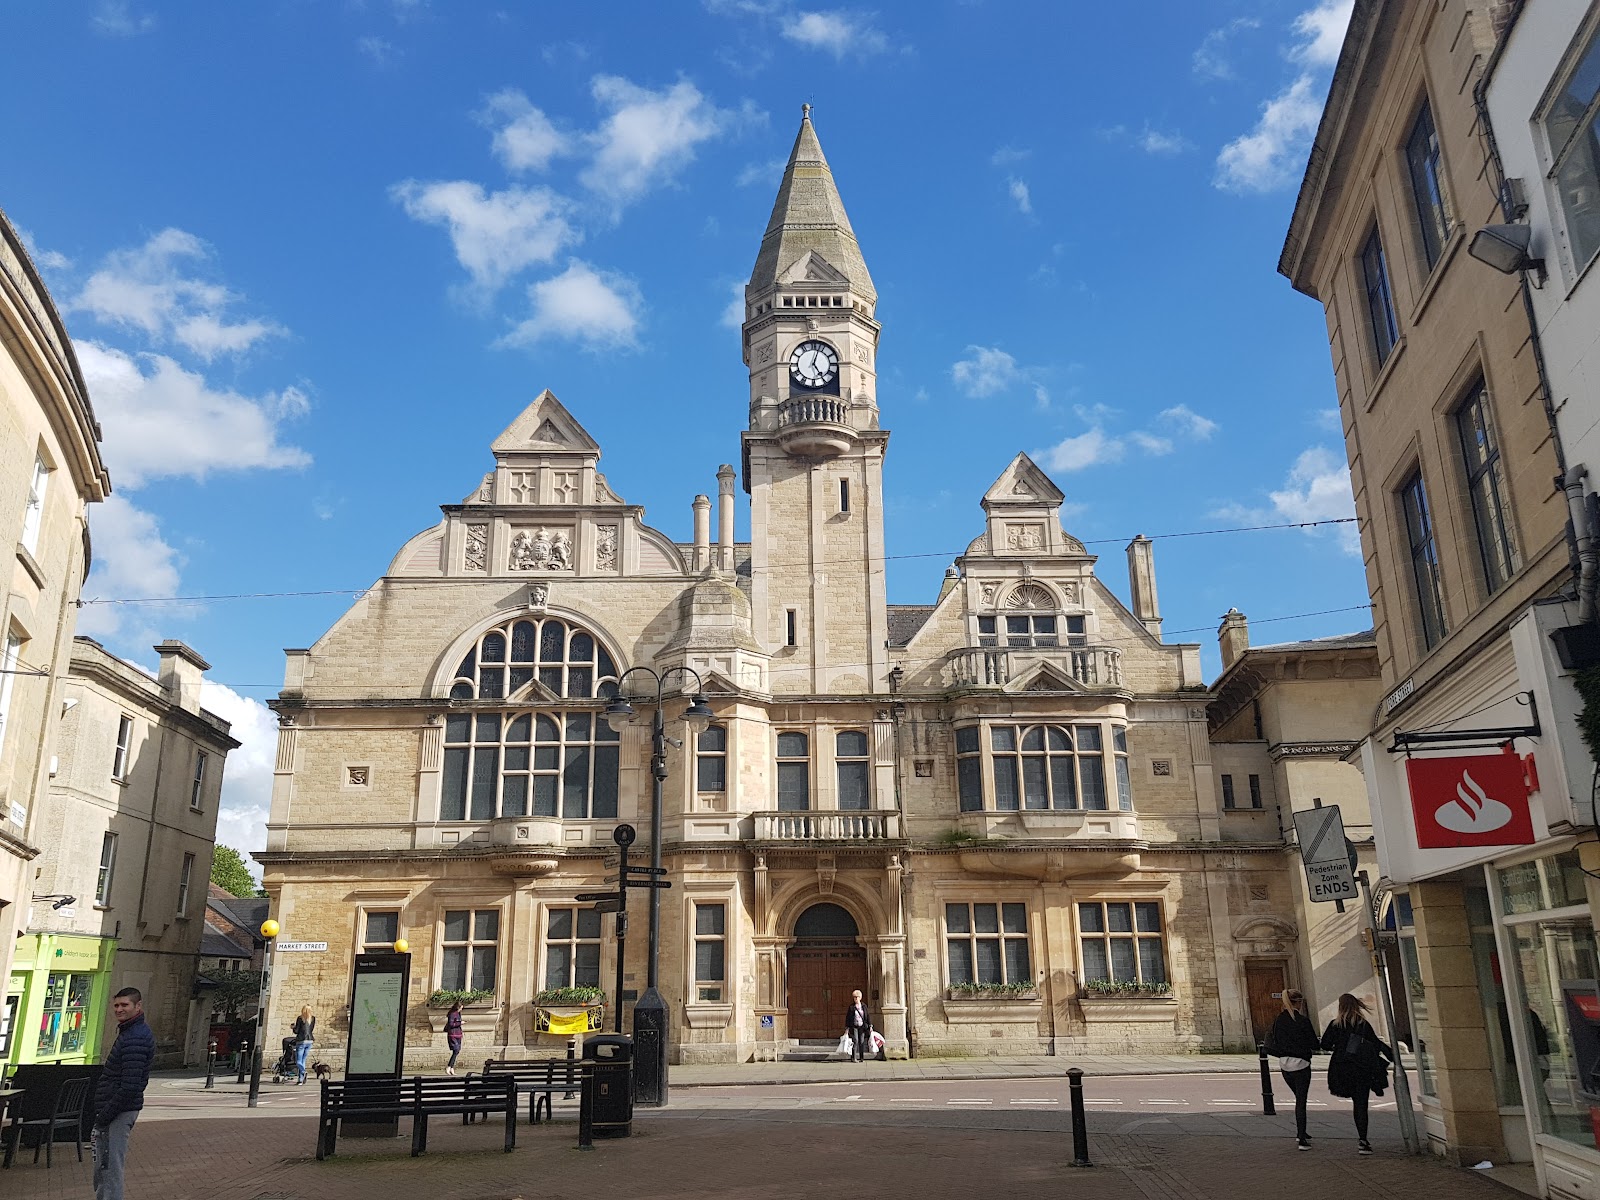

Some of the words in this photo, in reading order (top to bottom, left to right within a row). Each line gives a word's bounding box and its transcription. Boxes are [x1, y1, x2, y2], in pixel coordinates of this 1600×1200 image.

[1387, 692, 1398, 709] FORE
[1397, 680, 1412, 701] STREET
[1309, 863, 1348, 874] Pedestrian
[1321, 874, 1339, 882] Zone
[1315, 881, 1350, 895] ENDS
